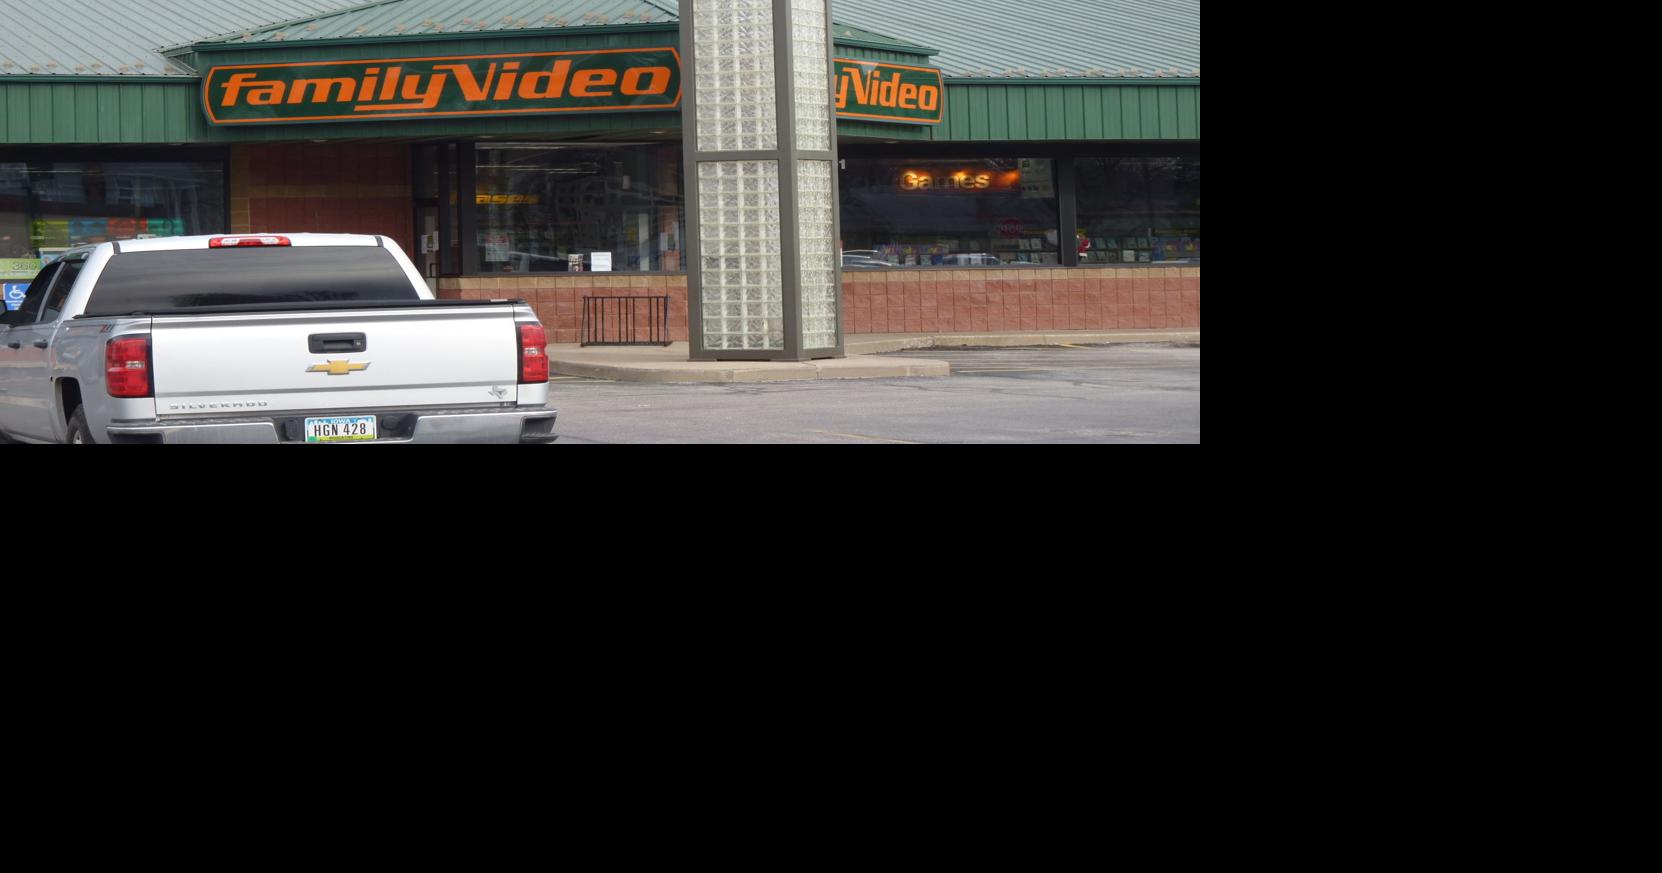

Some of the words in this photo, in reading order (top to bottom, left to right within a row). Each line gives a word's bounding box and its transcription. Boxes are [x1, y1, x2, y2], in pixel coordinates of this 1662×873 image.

[900, 170, 990, 190] Games
[314, 424, 338, 437] HGN
[343, 423, 366, 435] 428
